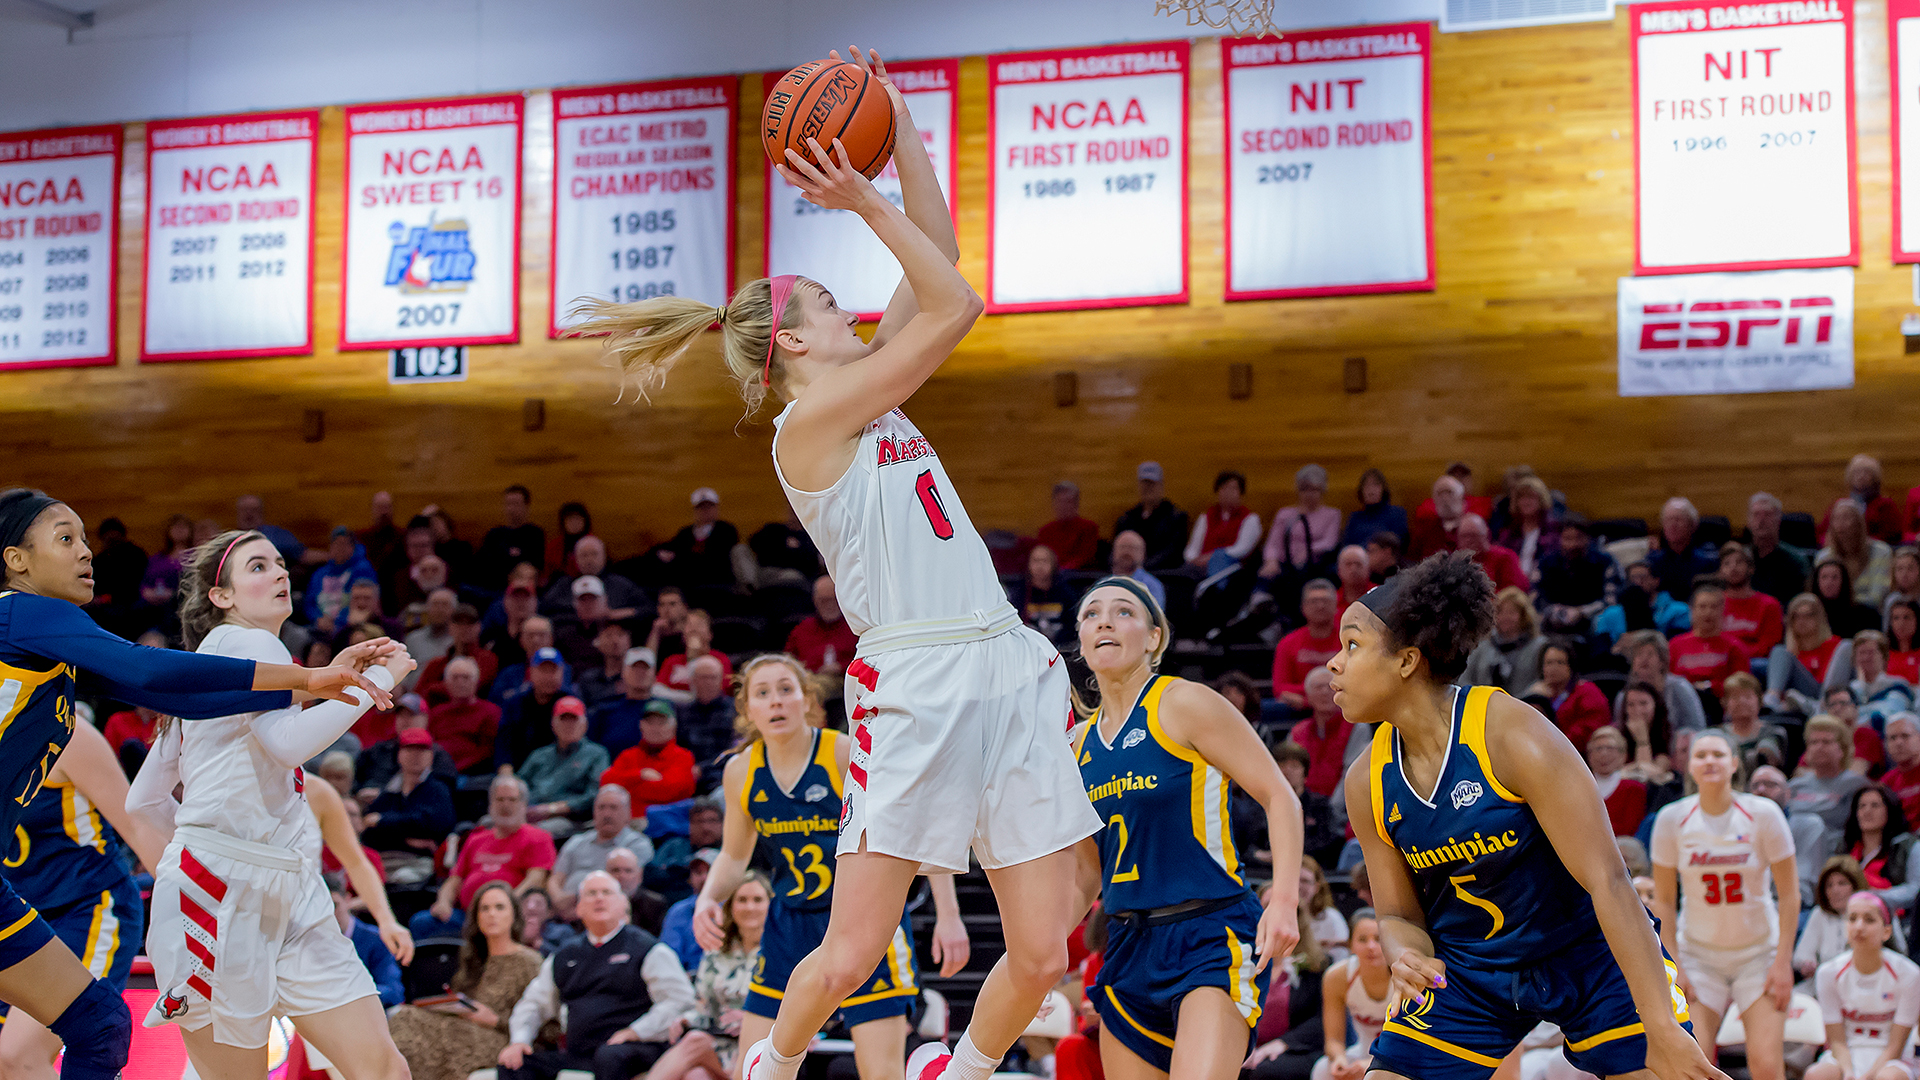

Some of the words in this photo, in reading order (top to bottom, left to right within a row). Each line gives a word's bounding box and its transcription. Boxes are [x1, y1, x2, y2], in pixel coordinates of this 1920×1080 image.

[1641, 8, 1707, 33] MEN'S
[1708, 1, 1844, 29] BASKETBALL
[1231, 42, 1294, 65] MEN'S
[1295, 32, 1422, 60] BASKETBALL
[997, 59, 1059, 82] MEN'S
[1060, 50, 1182, 79] BASKETBALL
[1704, 48, 1782, 82] NIT
[616, 86, 727, 114] BASKETBALL
[1290, 79, 1364, 113] NIT
[1654, 97, 1729, 121] FIRST
[1741, 90, 1831, 116] ROUND
[425, 101, 519, 128] BASKETBALL
[637, 118, 707, 142] METRO
[767, 91, 793, 141] ROCK
[1031, 98, 1146, 131] NCAA
[1008, 142, 1077, 168] FIRST
[1086, 137, 1171, 164] ROUND
[1241, 125, 1331, 154] SECOND
[1337, 120, 1413, 147] ROUND
[1673, 136, 1727, 152] 1996
[1760, 130, 1816, 149] 2007
[383, 145, 485, 176] NCAA
[1257, 163, 1314, 184] 2007
[182, 162, 280, 194] NCAA
[362, 179, 464, 208] SWEET
[475, 176, 504, 200] 16
[570, 166, 716, 199] CHAMPIONS
[0, 217, 27, 240] ST
[34, 212, 102, 238] ROUND
[159, 203, 232, 229] SECOND
[237, 199, 300, 223] ROUND
[611, 208, 678, 236] 1985
[611, 244, 675, 272] 1987
[397, 303, 462, 329] 2007
[1639, 297, 1834, 351] ESPN
[401, 345, 458, 378] 103
[915, 469, 954, 541] 0
[1087, 771, 1158, 803] innipiac
[1453, 784, 1481, 803] MAAC
[755, 814, 838, 838] Quinnipiac
[1108, 813, 1140, 884] 2
[1401, 830, 1519, 874] uinnipiac
[781, 843, 833, 900] 13
[1702, 872, 1744, 905] 32
[1449, 873, 1505, 941] 5
